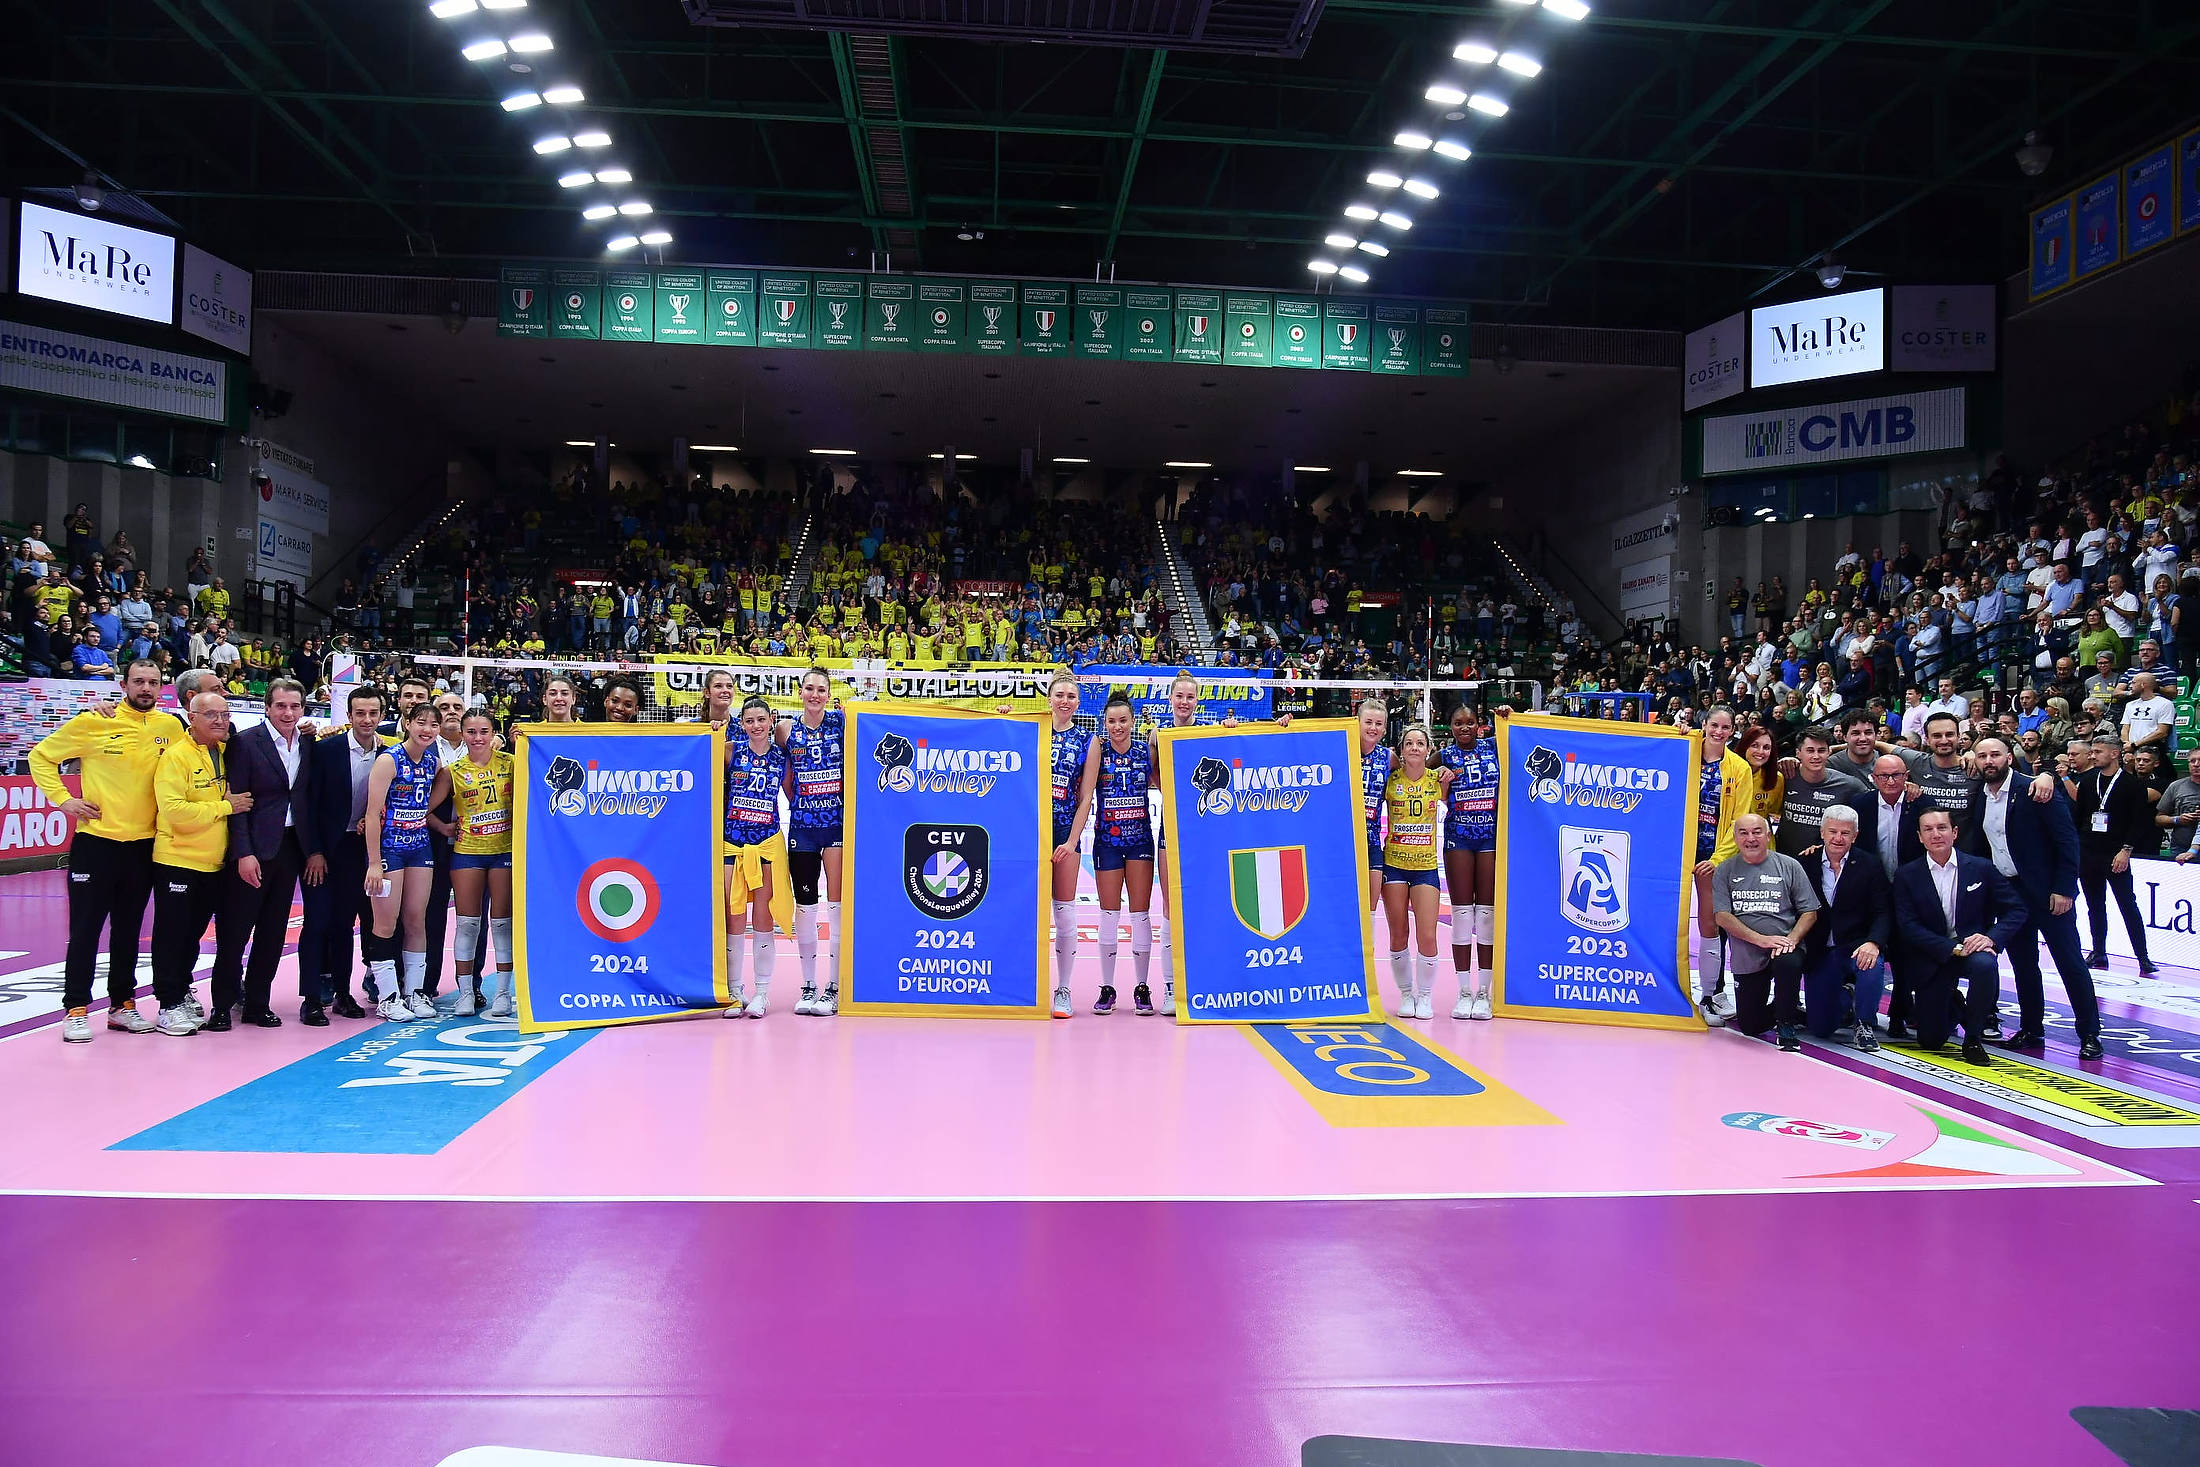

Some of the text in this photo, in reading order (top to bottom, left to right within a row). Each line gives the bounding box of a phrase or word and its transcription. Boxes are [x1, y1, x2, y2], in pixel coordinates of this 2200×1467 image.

[43, 269, 151, 297] UNDERWEAR
[190, 293, 245, 329] COSTER
[1902, 332, 1986, 345] COSTER
[0, 334, 216, 387] ENTROMARCA BANCA
[1773, 345, 1866, 364] UNDERWEAR
[1689, 357, 1740, 386] COSTER
[1785, 418, 1796, 455] Banca
[1799, 406, 1916, 452] CMB
[278, 534, 312, 554] CARRARO
[1277, 704, 1307, 712] LEGEND
[812, 746, 822, 764] 9
[747, 773, 767, 793] 20
[799, 771, 830, 781] PROSECCO
[916, 769, 997, 797] Volley
[1121, 772, 1127, 791] 1
[1467, 764, 1481, 784] 15
[415, 783, 425, 803] 6
[482, 785, 498, 804] 21
[1233, 788, 1310, 813] Volley
[1456, 789, 1486, 800] PROSECCO
[1563, 783, 1642, 814] Volley
[1920, 785, 1956, 798] PROSECCO
[587, 792, 669, 818] Volley
[734, 798, 765, 809] PROSECCO
[1104, 798, 1136, 807] PROSECCO
[1408, 800, 1423, 817] 10
[1783, 801, 1820, 816] PROSECCO
[0, 811, 68, 850] ARO
[1393, 823, 1424, 832] PROSECCO
[789, 839, 797, 848] 9
[927, 831, 966, 845] CEV
[1583, 833, 1604, 845] LVF
[1731, 890, 1769, 900] PROSECCO
[2145, 882, 2197, 934] La
[1575, 913, 1622, 927] SUPERCOPPA
[915, 930, 976, 949] 2024
[1566, 936, 1628, 958] 2023
[590, 954, 648, 974] 2024
[898, 957, 992, 976] CAMPIONI
[1245, 946, 1304, 968] 2024
[898, 976, 991, 994] D'EUROPA
[1537, 963, 1657, 988] SUPERCOPPA
[559, 993, 688, 1008] COPPA ITALIA
[1191, 982, 1362, 1010] CAMPIONI D'ITALIA
[1554, 984, 1641, 1005] ITALIANA
[336, 1039, 398, 1063] good
[1285, 1024, 1431, 1085] ECO
